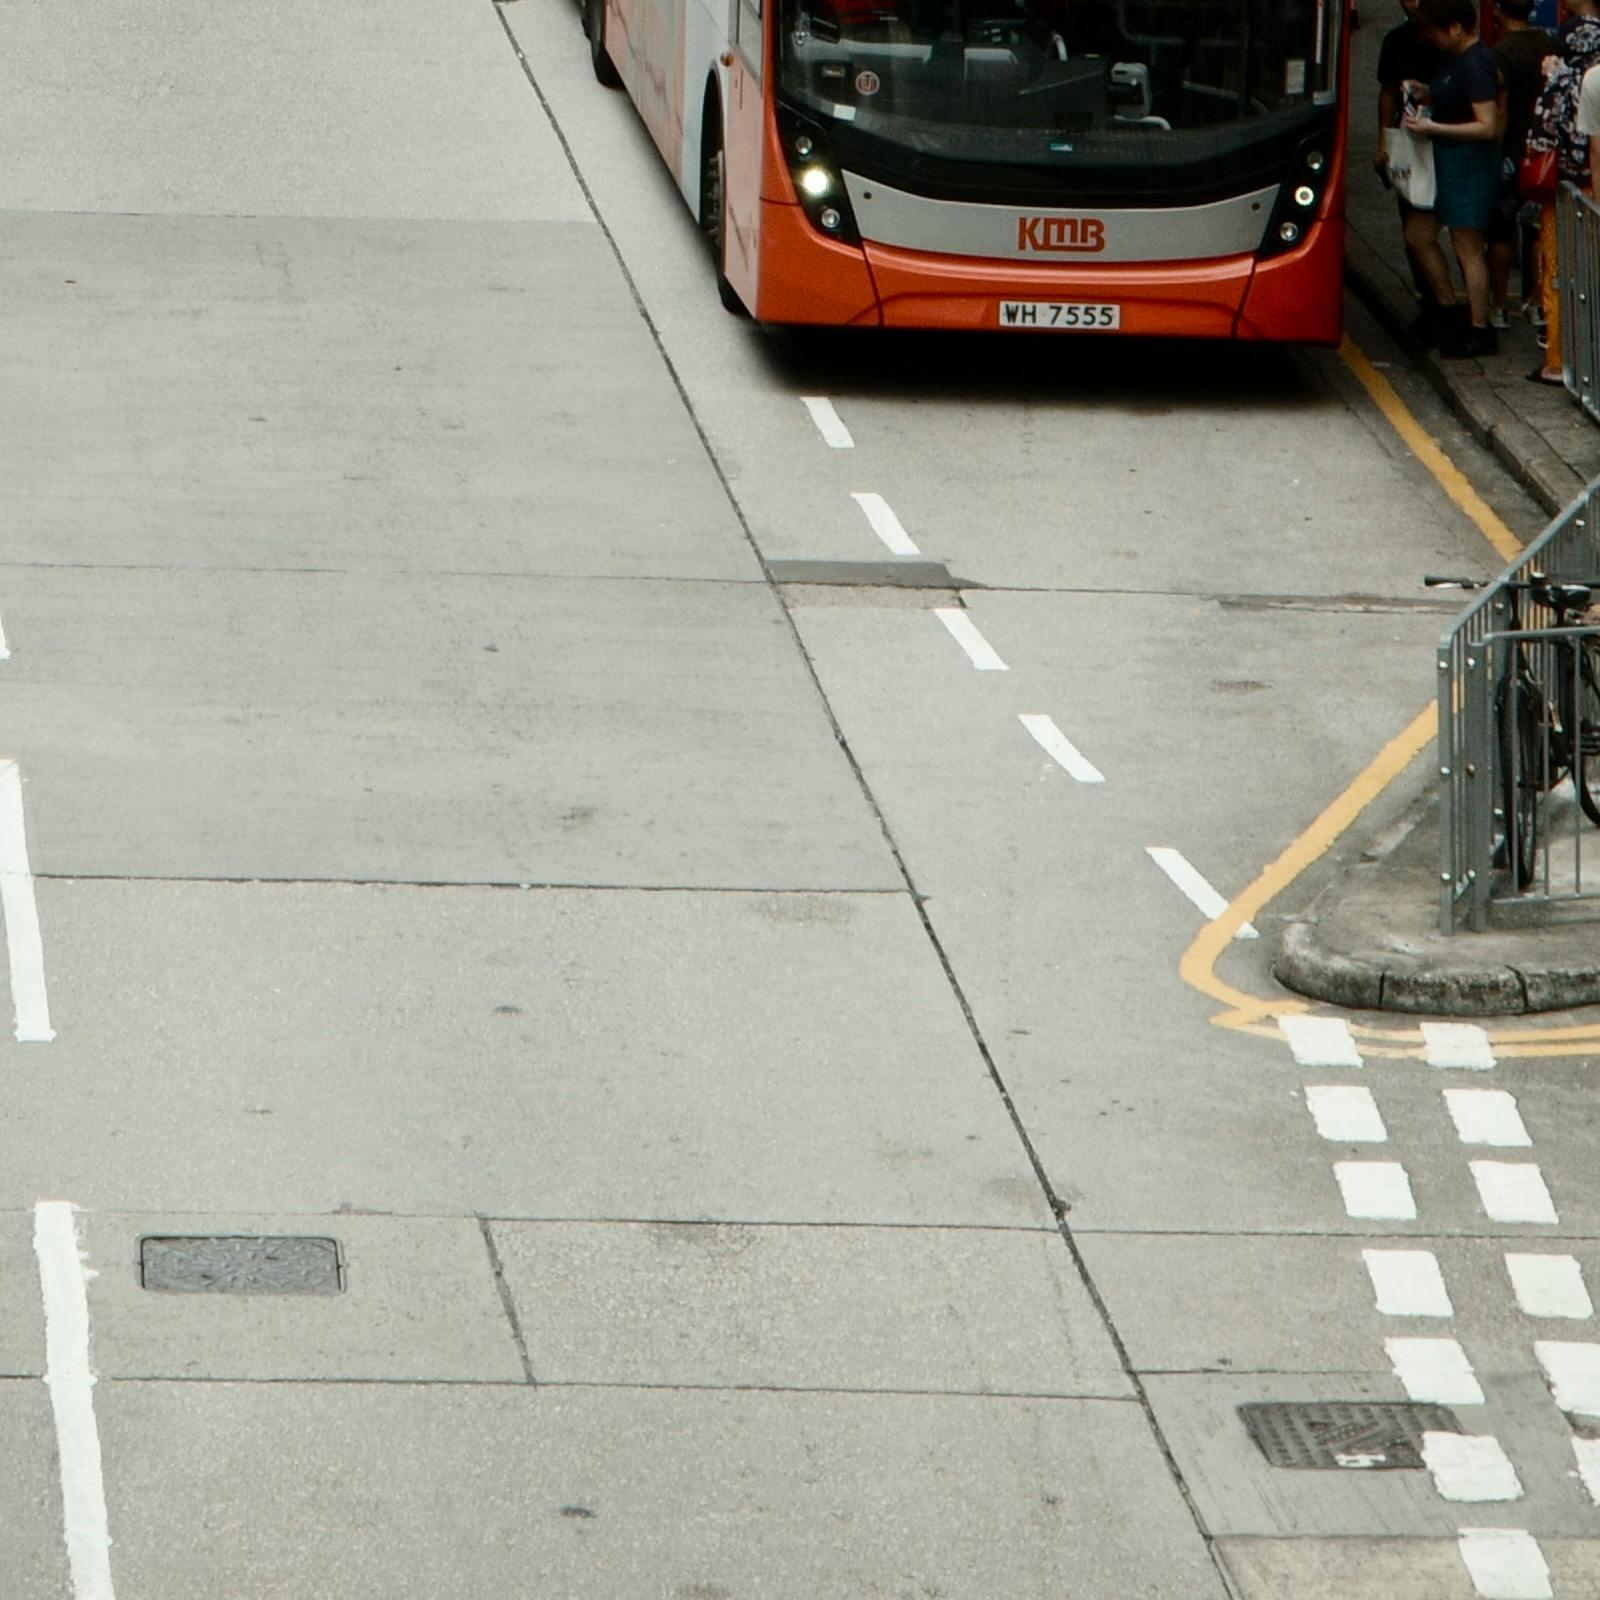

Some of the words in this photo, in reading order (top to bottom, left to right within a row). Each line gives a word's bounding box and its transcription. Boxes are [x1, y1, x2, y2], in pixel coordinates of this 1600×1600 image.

[1018, 217, 1105, 253] KMB
[1004, 303, 1037, 324] WH
[1049, 305, 1114, 326] 7555
